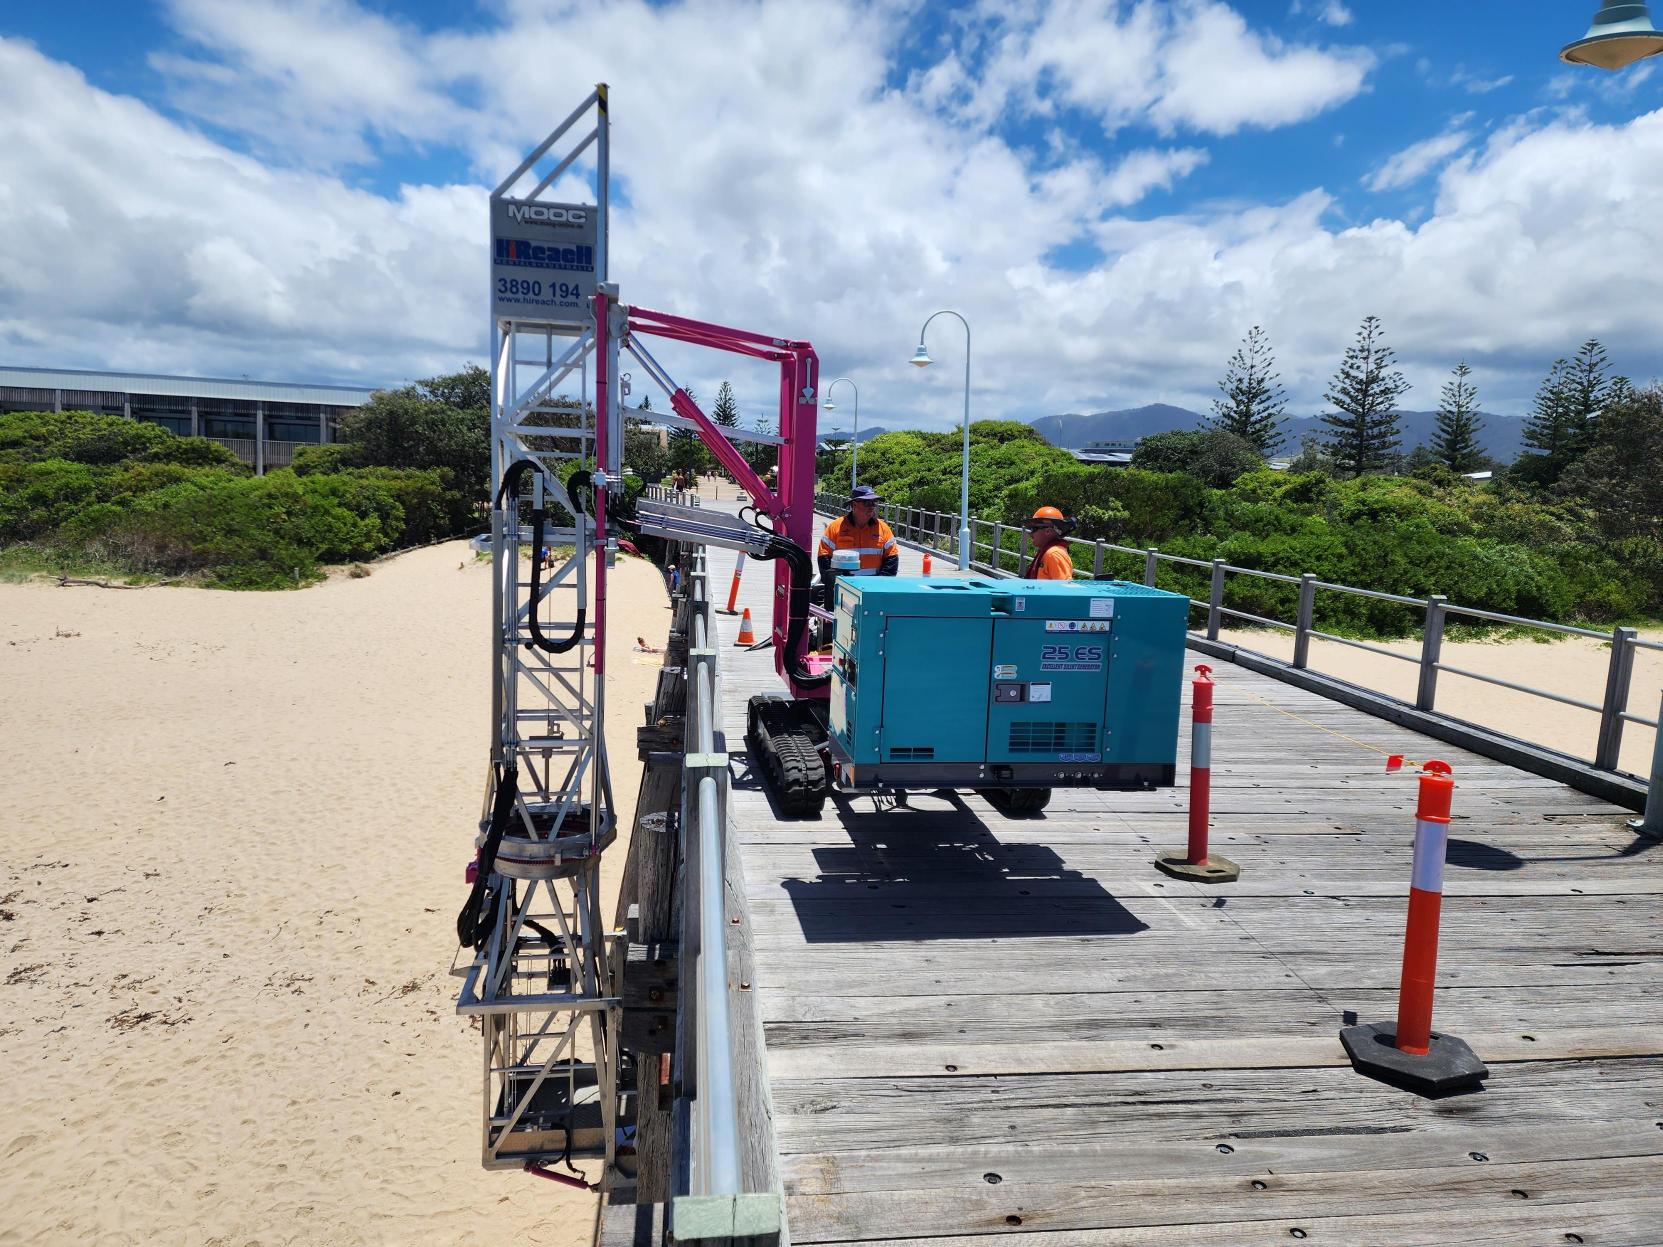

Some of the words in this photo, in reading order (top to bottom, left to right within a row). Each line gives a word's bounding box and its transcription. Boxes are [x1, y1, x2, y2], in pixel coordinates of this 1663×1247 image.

[497, 278, 542, 297] 3890
[549, 282, 580, 299] 194
[1041, 645, 1070, 661] 25
[1074, 646, 1102, 661] ES
